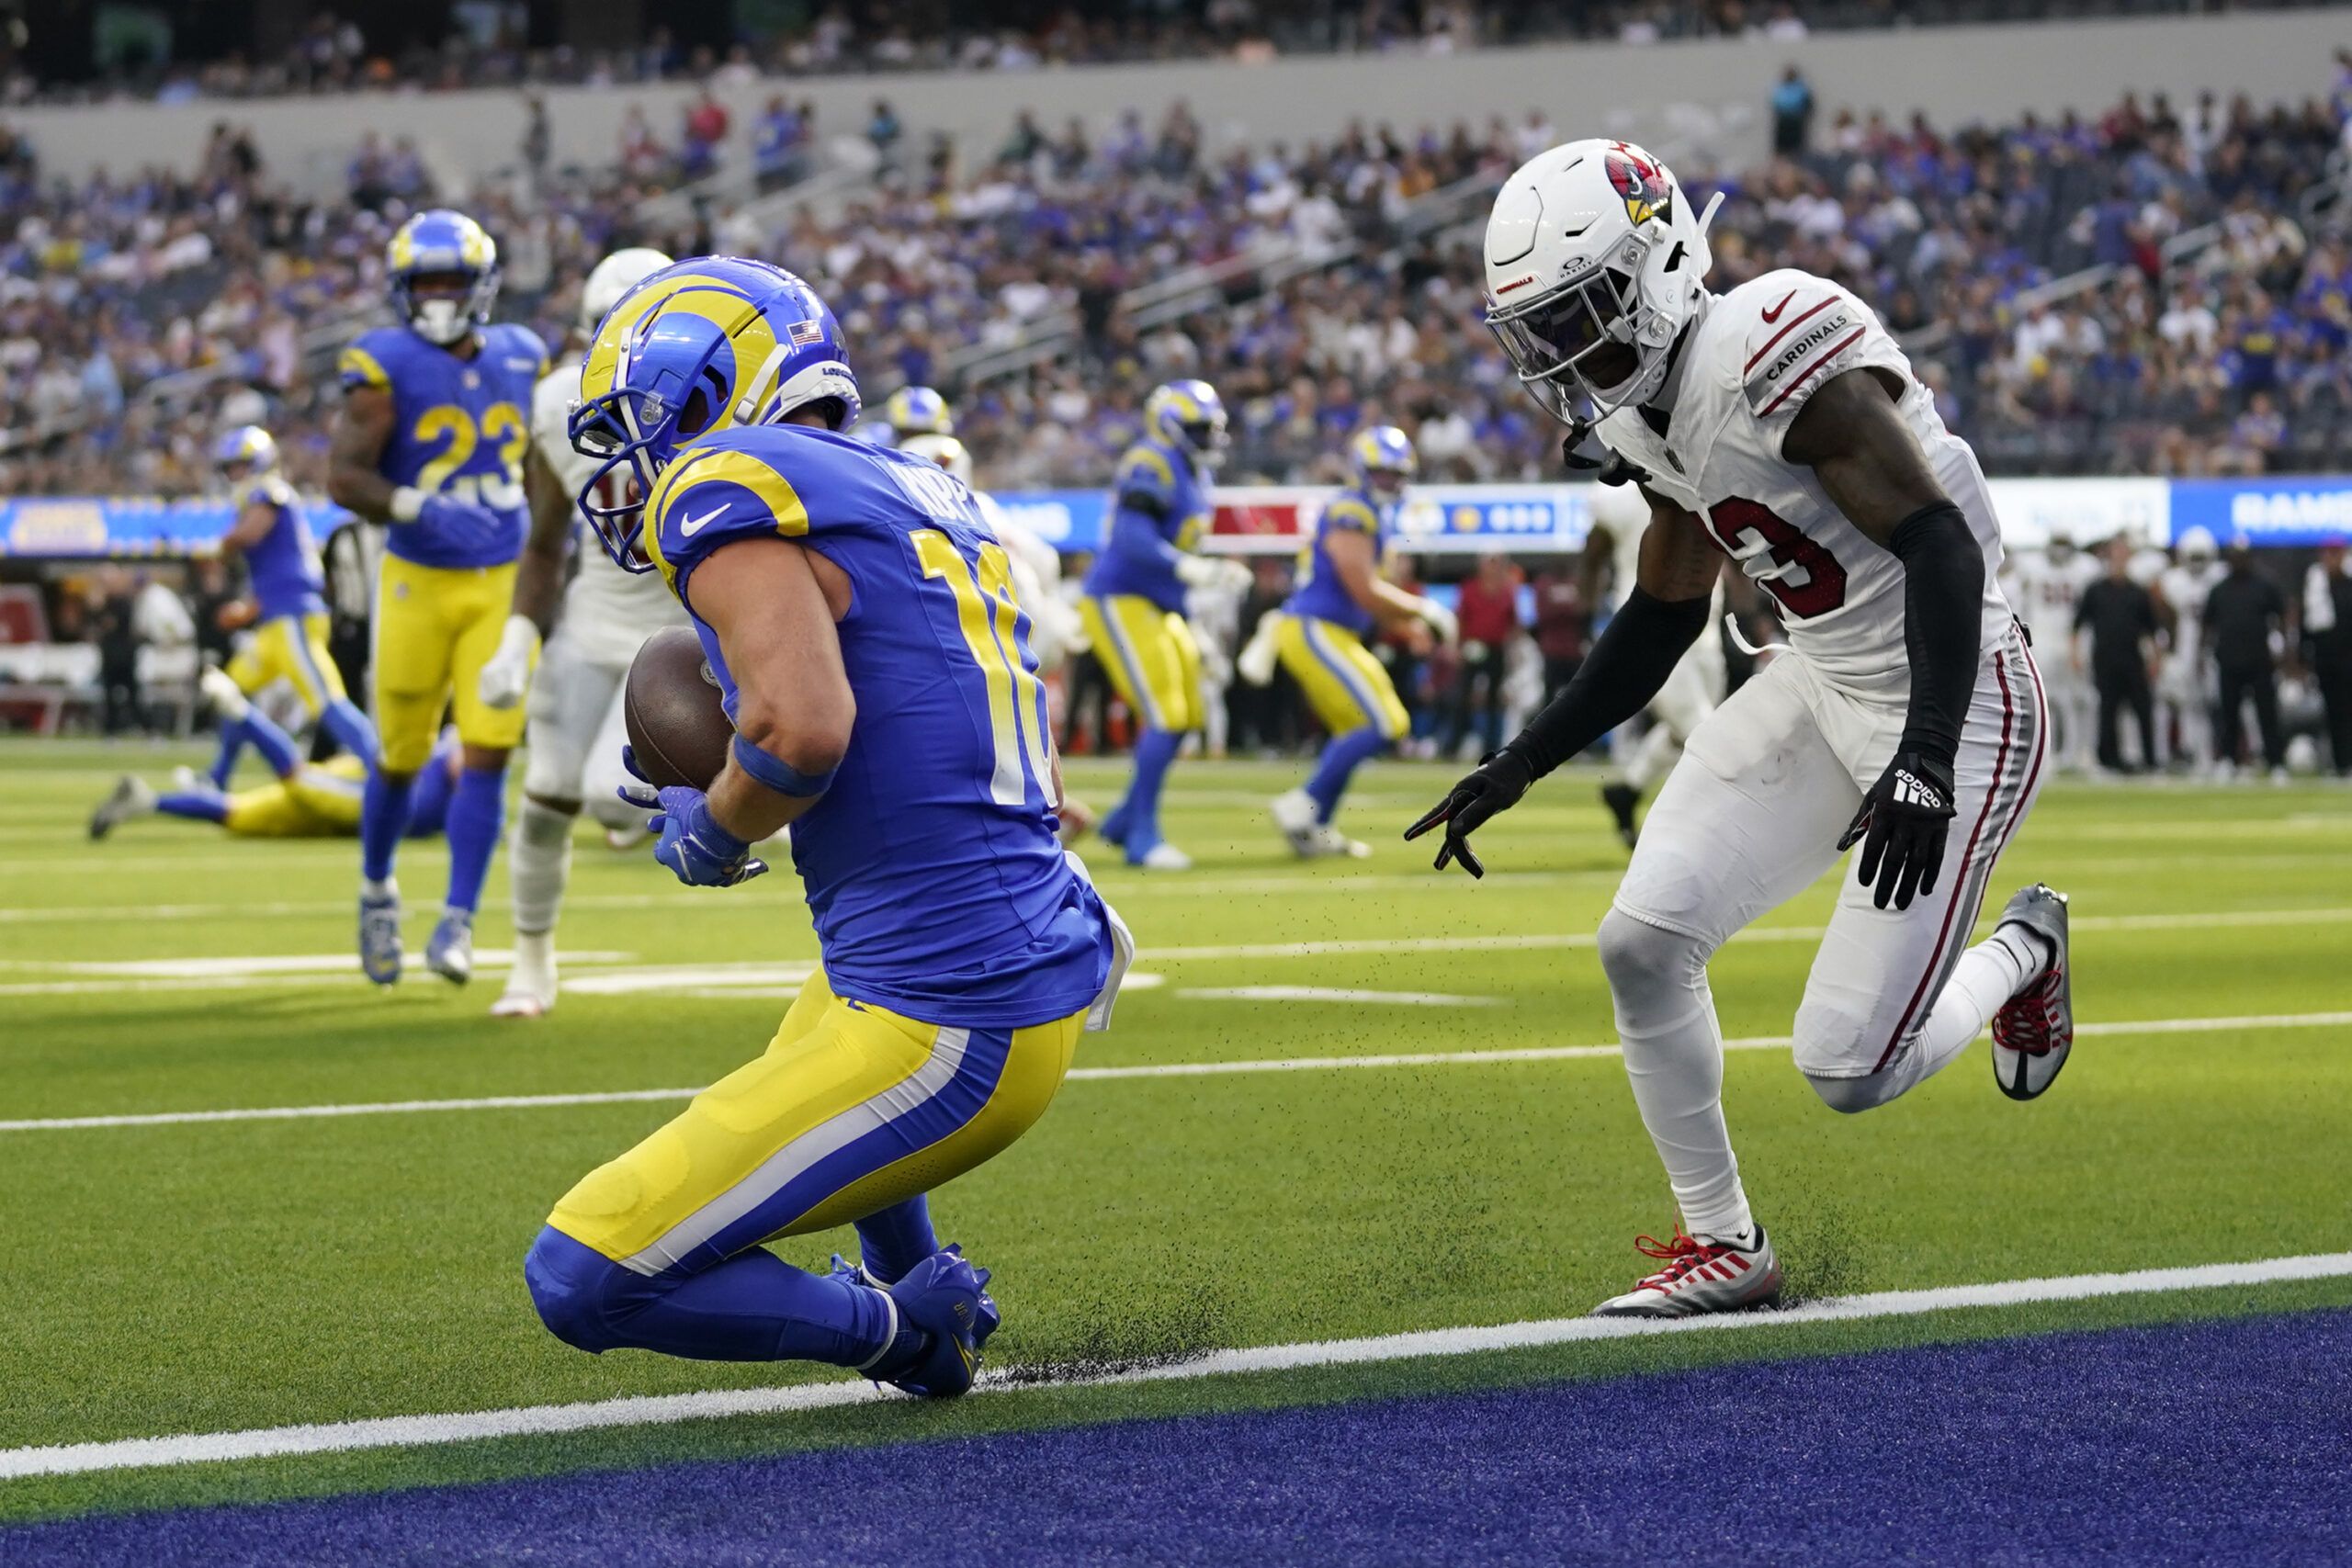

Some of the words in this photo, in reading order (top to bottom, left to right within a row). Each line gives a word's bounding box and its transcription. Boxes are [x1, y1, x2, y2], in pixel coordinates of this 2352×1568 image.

[1496, 276, 1533, 295] CARDINALS
[1766, 315, 1848, 381] CARDINALS
[415, 402, 529, 511] 23
[1697, 494, 1849, 620] 3
[909, 528, 1058, 808] 10
[1894, 768, 1941, 808] adidas
